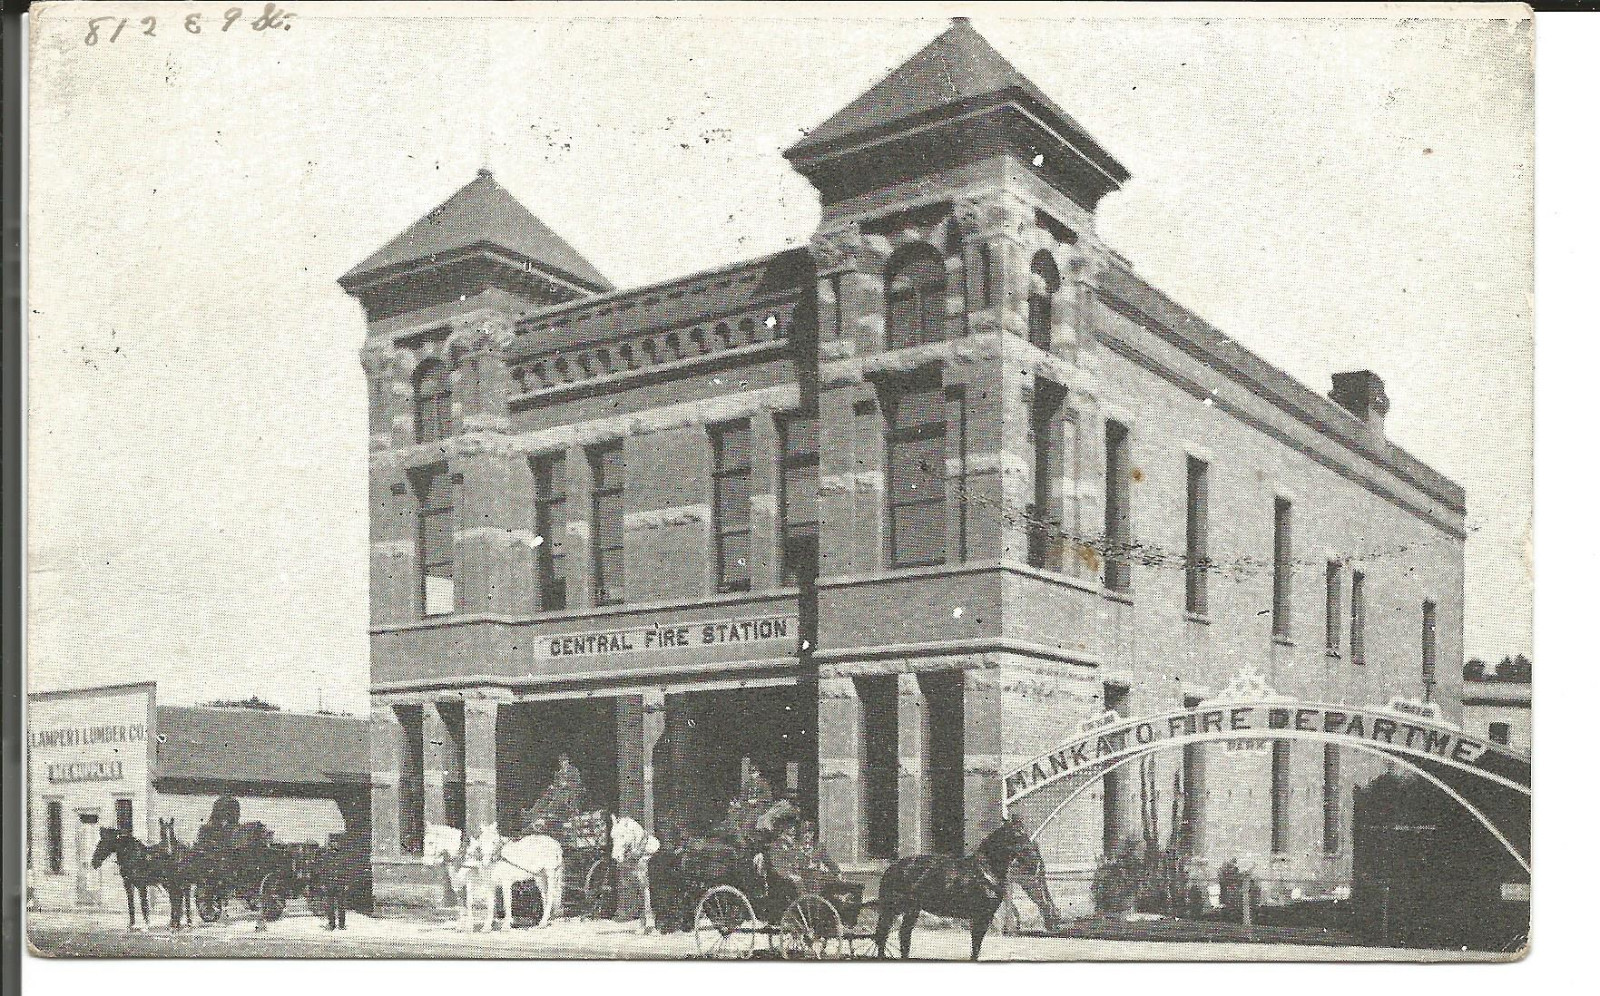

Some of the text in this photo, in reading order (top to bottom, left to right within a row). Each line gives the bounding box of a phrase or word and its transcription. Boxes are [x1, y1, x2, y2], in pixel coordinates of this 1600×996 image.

[221, 7, 242, 32] 9
[550, 619, 788, 656] CENTRAL FIRE STATION
[83, 725, 126, 745] LUMBER
[1005, 723, 1154, 798] MANKATO
[1168, 707, 1254, 738] FIRE
